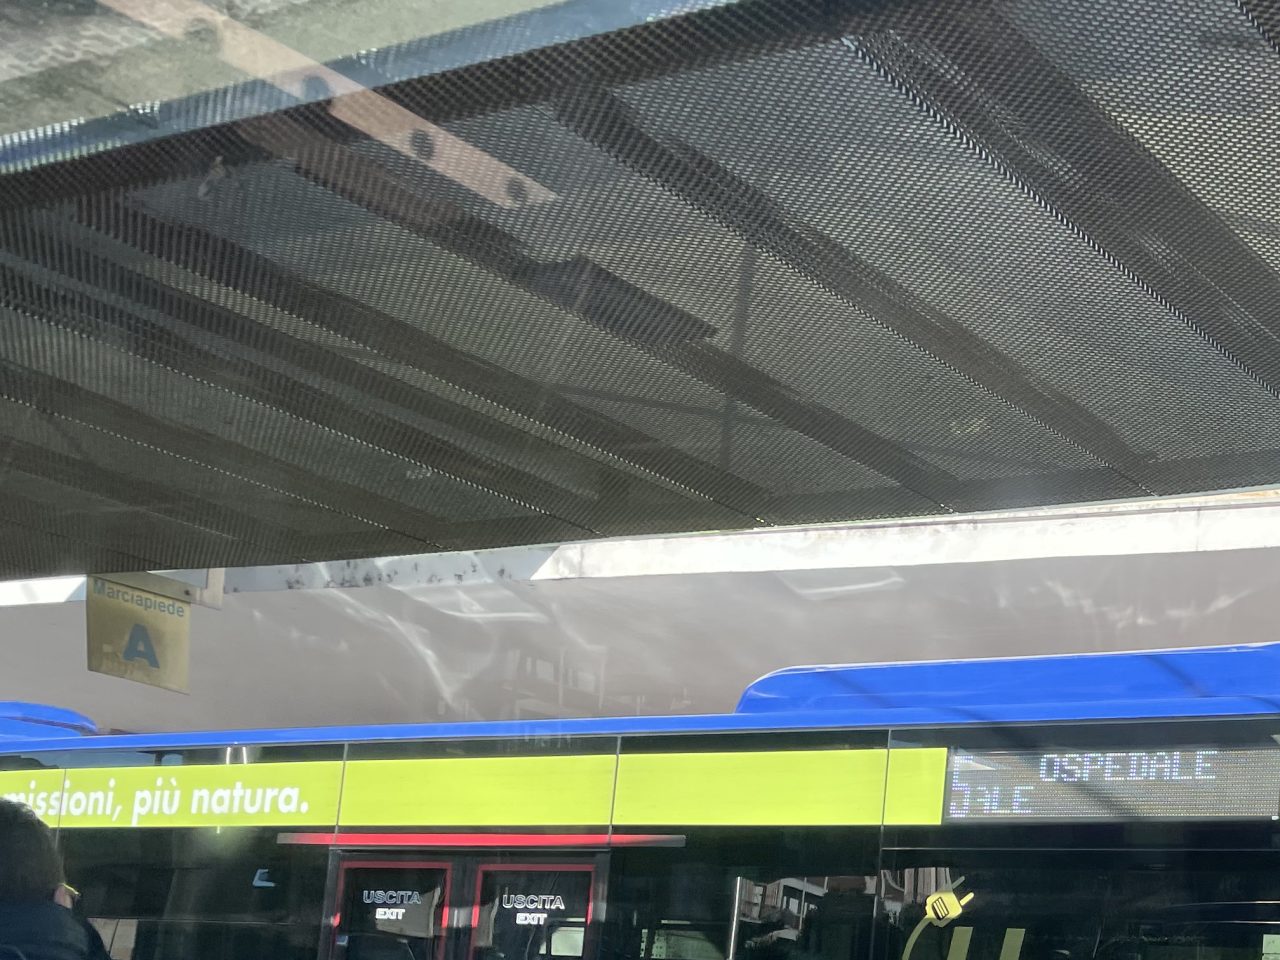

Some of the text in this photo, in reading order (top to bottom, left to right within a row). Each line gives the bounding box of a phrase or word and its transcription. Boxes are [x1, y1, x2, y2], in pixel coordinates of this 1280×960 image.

[93, 576, 186, 618] Marciapiede
[122, 622, 161, 669] A
[1039, 750, 1218, 783] OSPEDALE
[131, 775, 183, 829] più
[190, 780, 309, 815] natura.
[362, 889, 422, 905] USCITA
[502, 894, 566, 911] USCITA
[374, 907, 406, 920] EXIT
[515, 912, 548, 926] EXIT
